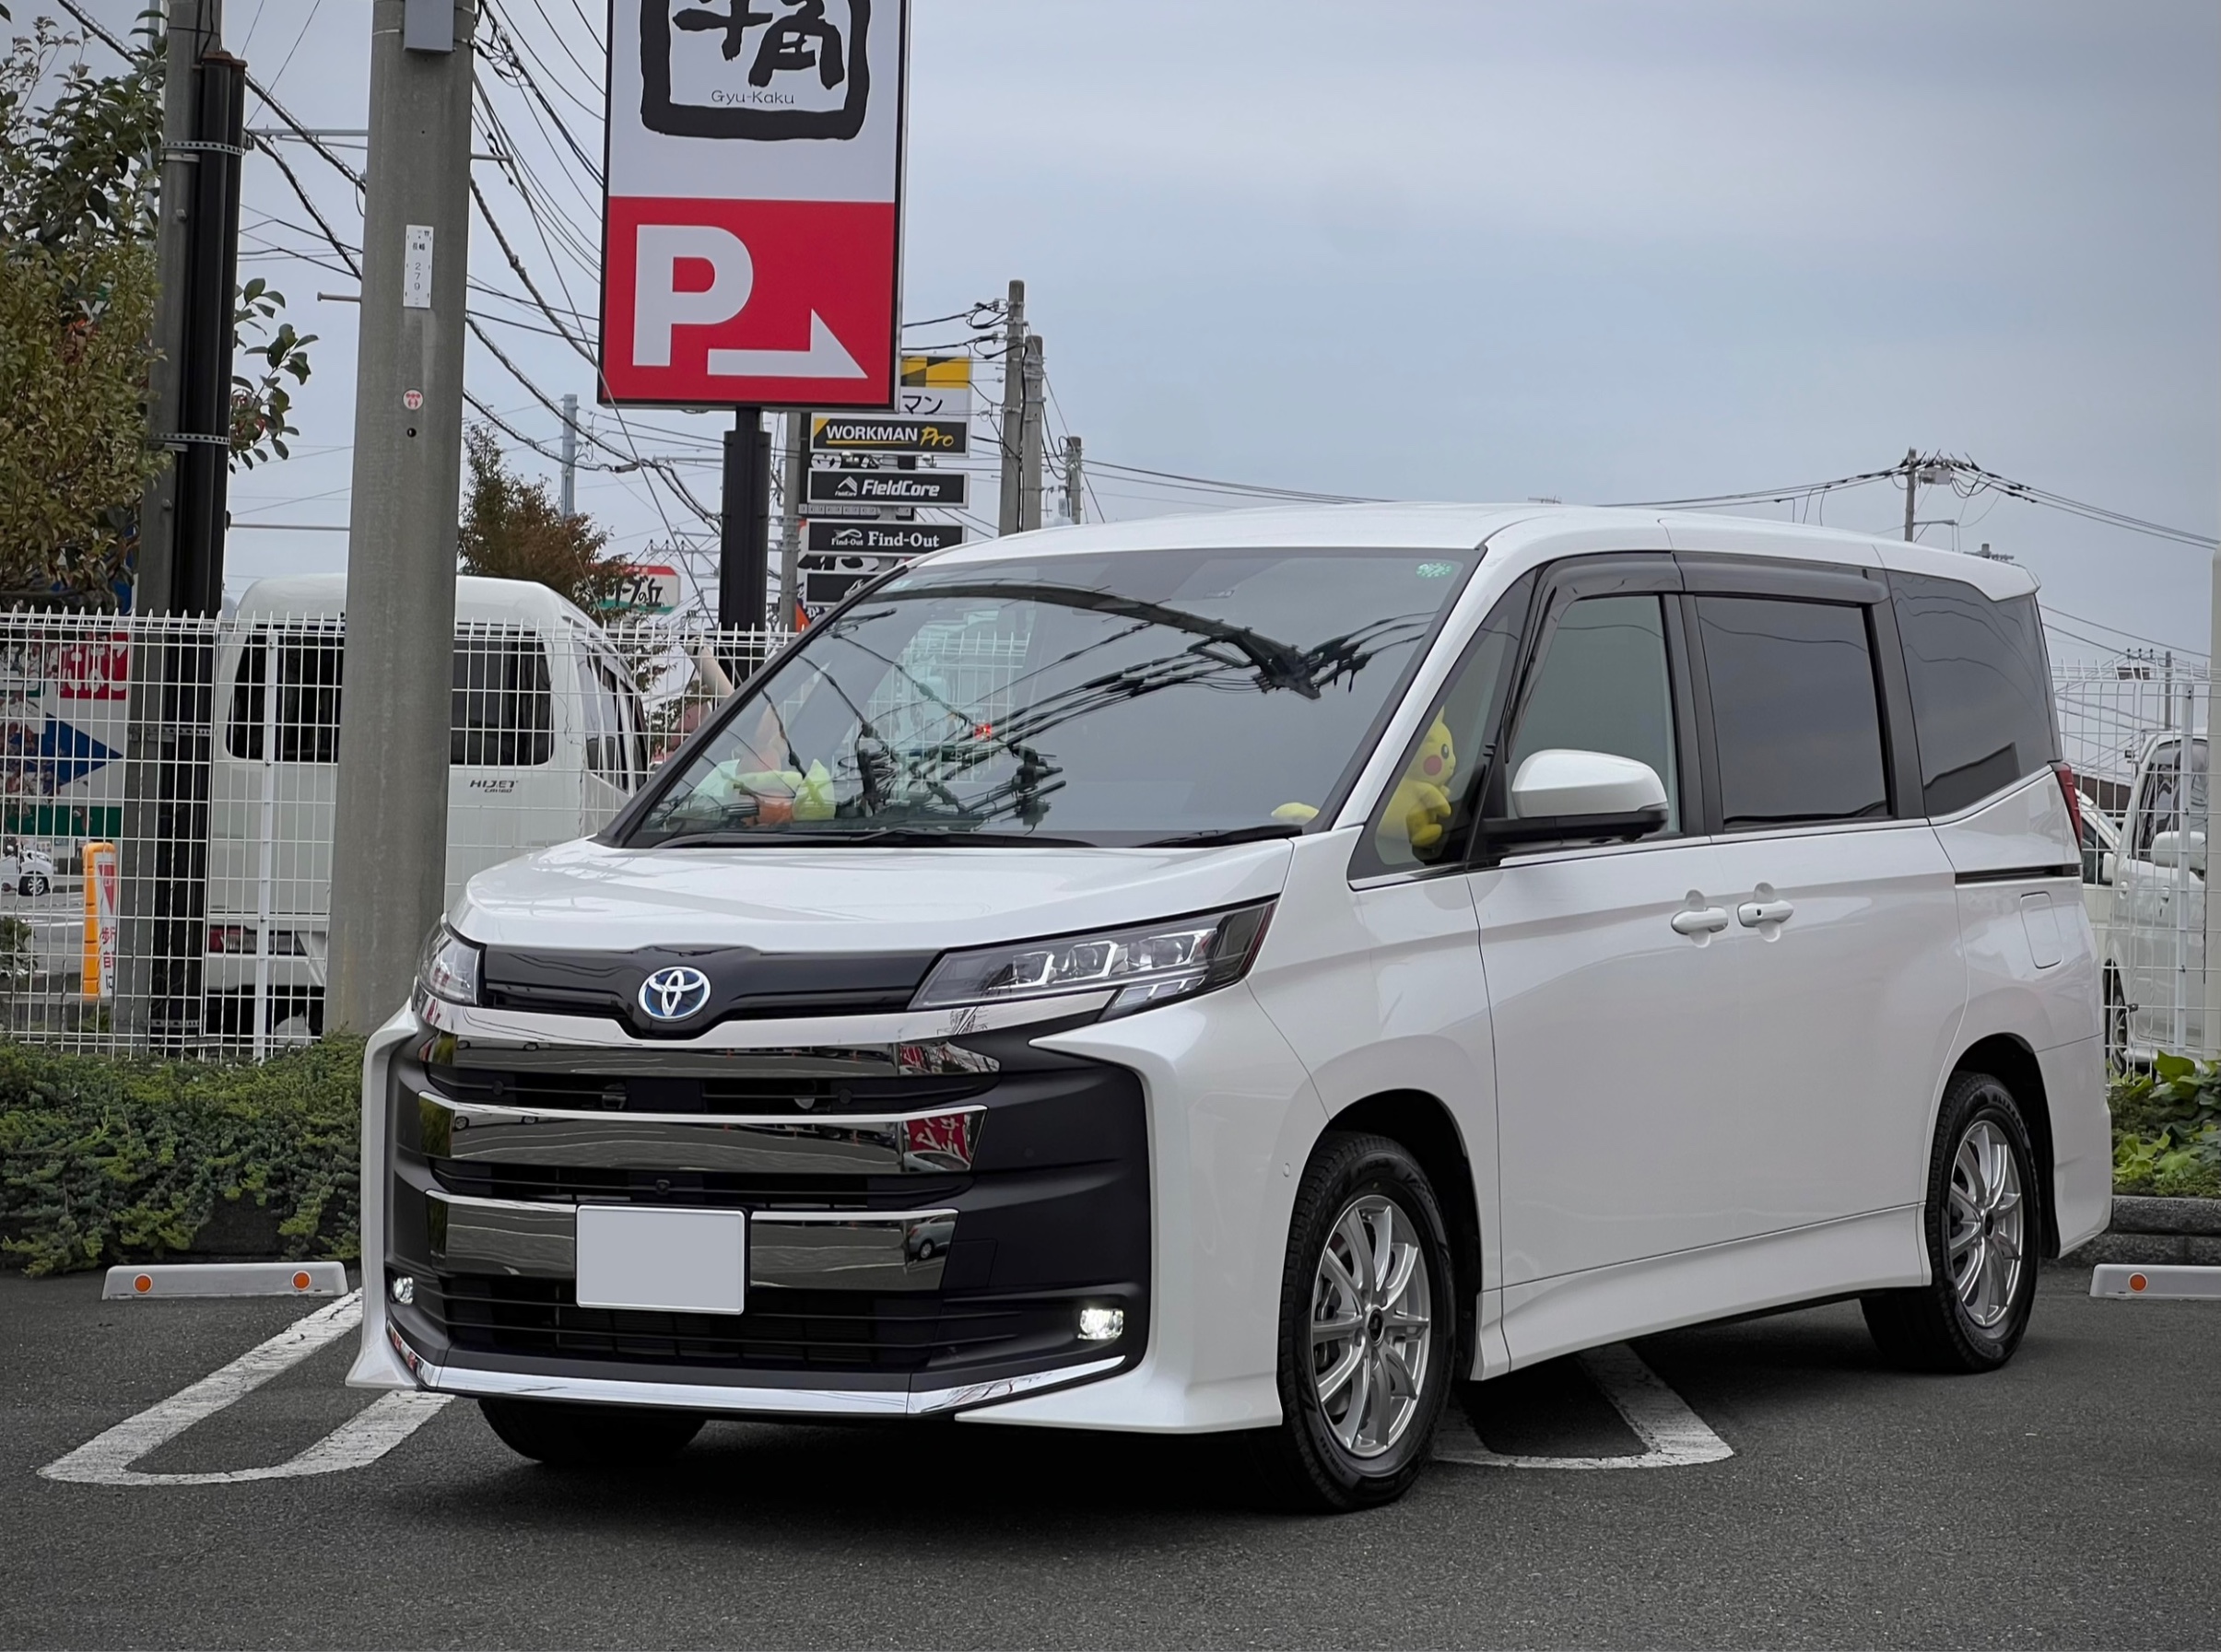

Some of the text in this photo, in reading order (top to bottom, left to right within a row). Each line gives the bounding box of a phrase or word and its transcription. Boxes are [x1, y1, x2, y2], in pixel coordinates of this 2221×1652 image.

[711, 89, 794, 105] Gyu-Kaku
[632, 224, 754, 367] P
[826, 425, 955, 447] WORKMAN Pro
[861, 478, 941, 498] FieldCore
[831, 530, 940, 548] Find-Out Find-Out
[469, 779, 515, 789] HIJET
